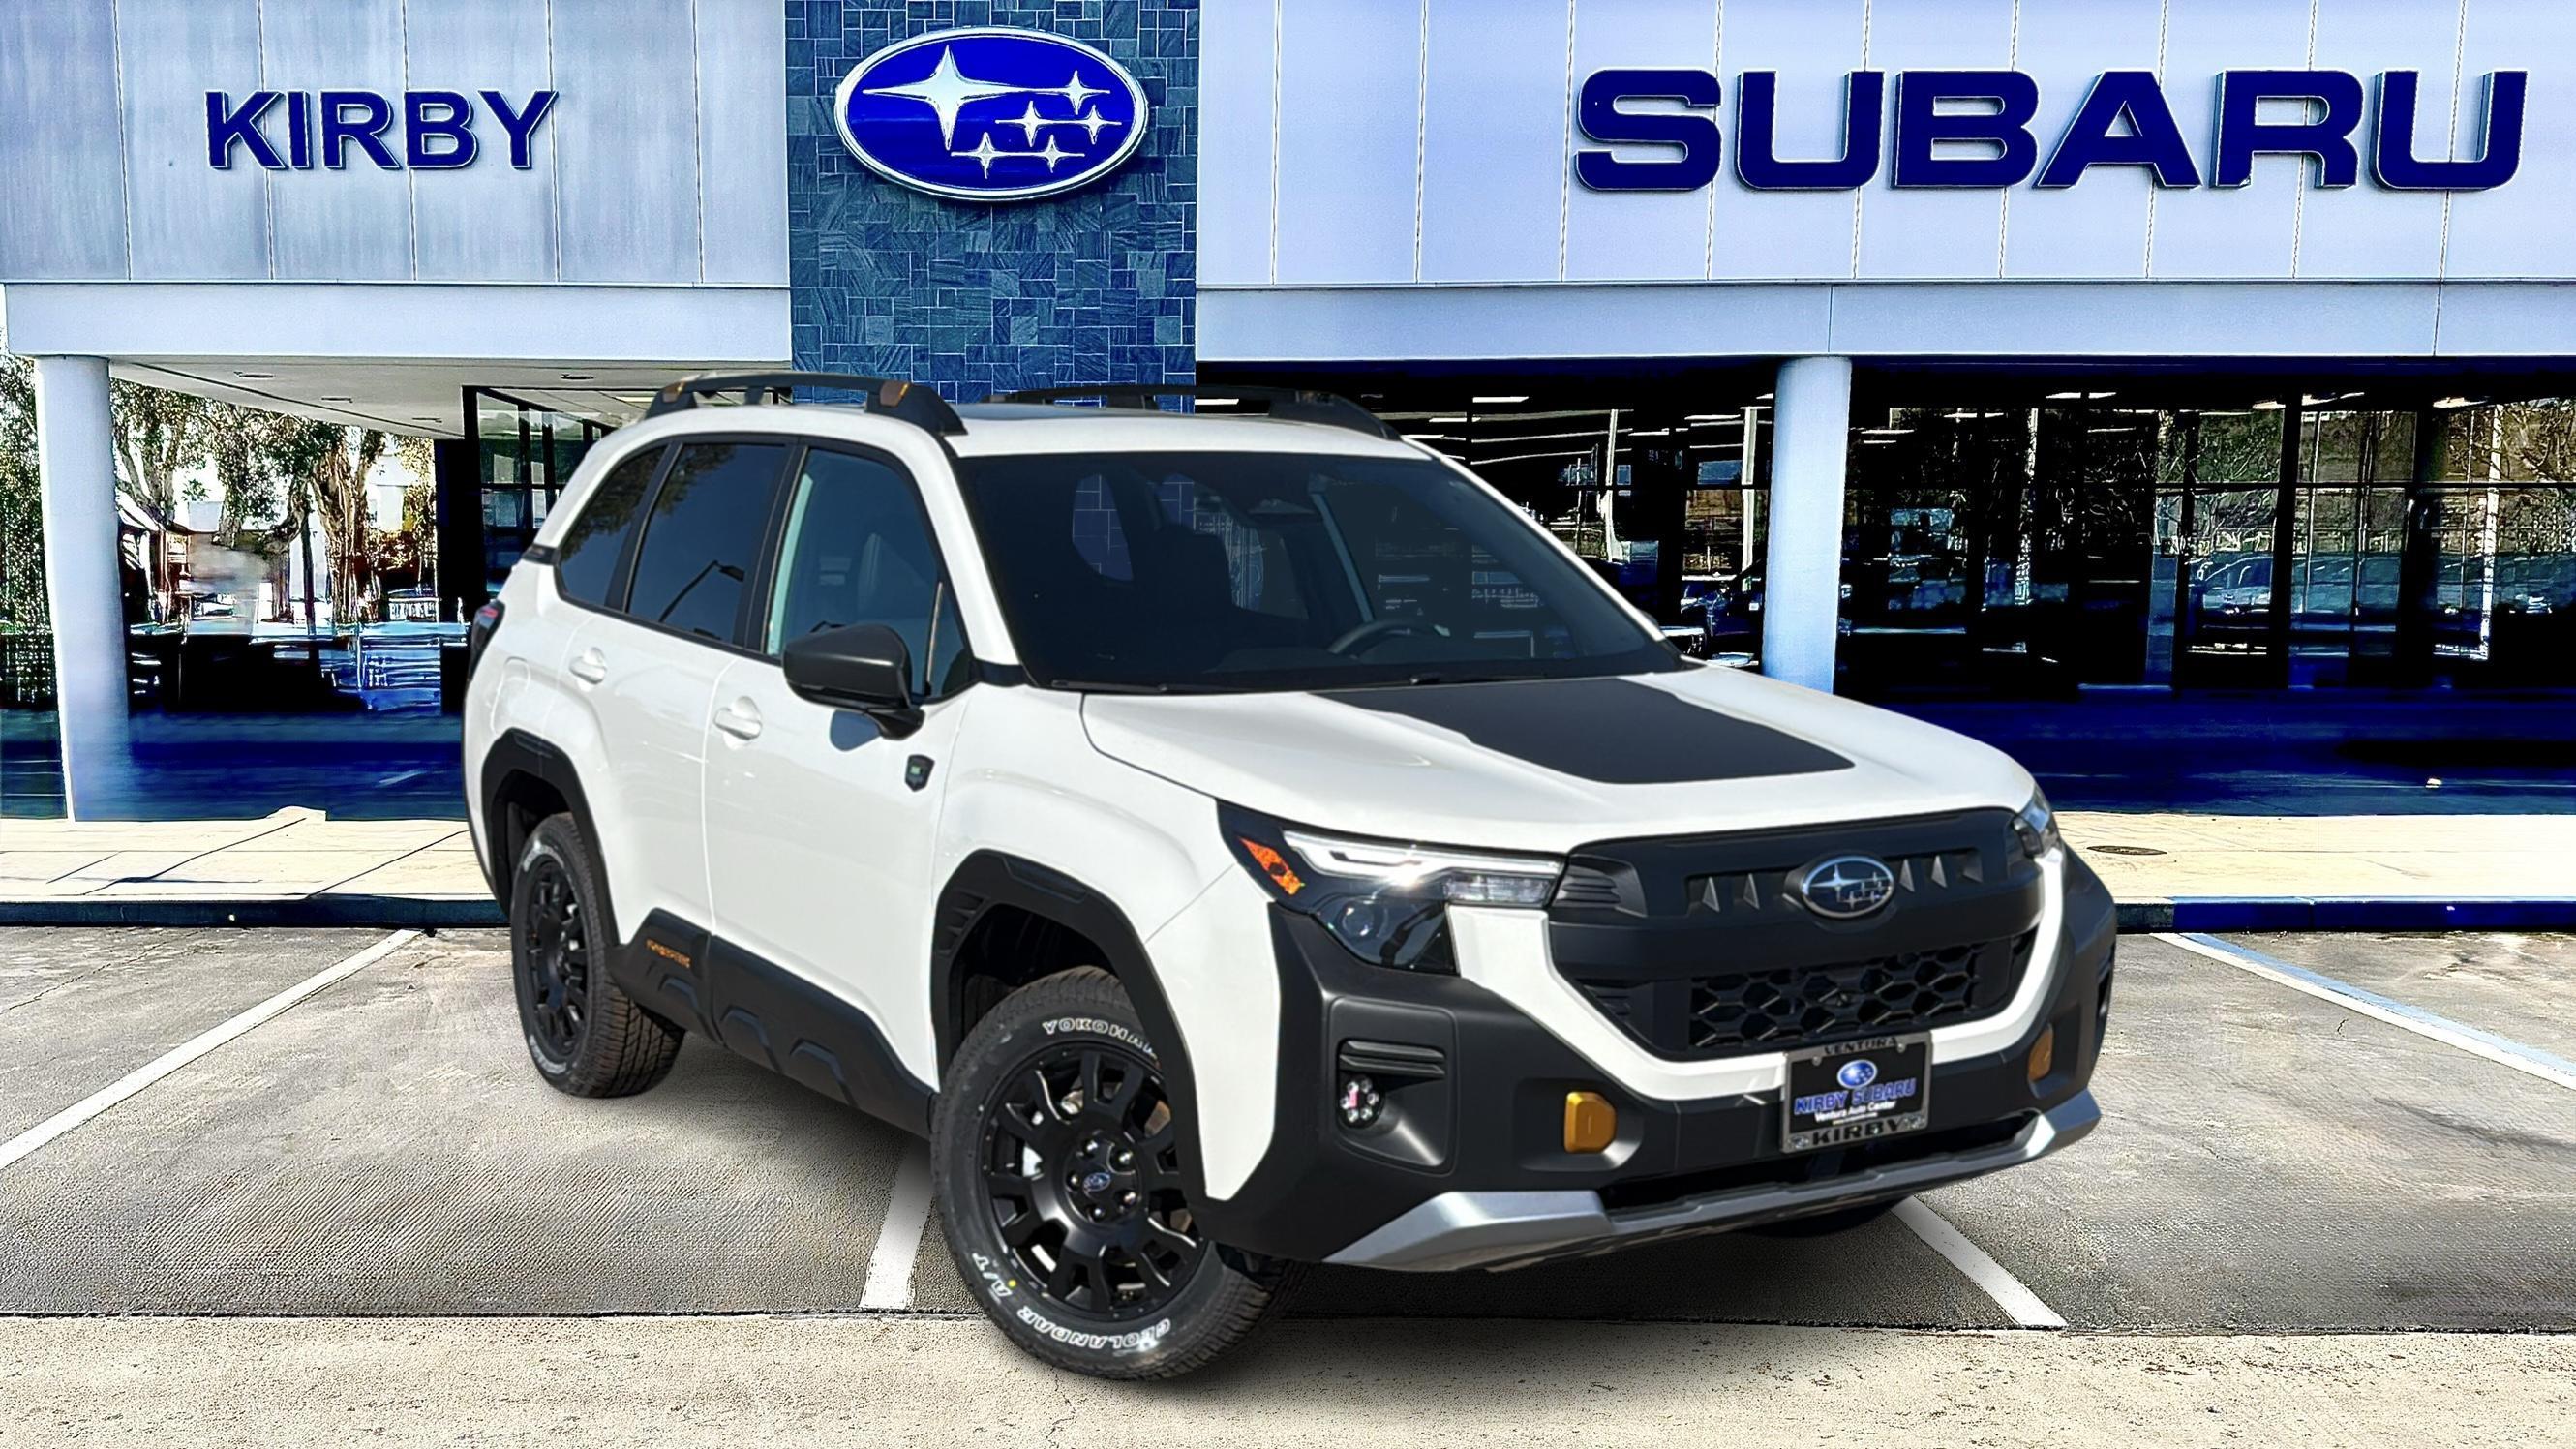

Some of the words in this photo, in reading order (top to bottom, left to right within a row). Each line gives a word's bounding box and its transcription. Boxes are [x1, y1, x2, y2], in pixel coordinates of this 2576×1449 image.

[204, 89, 559, 170] KIRBY
[1575, 68, 2529, 192] SUBARU
[1824, 1037, 1896, 1055] VENTURA
[1794, 1090, 1848, 1115] KIRBY
[1851, 1078, 1916, 1105] SUBARU
[1848, 1104, 1867, 1116] Auto
[1867, 1100, 1896, 1112] Center
[1812, 1118, 1903, 1145] KIRBY
[1016, 1305, 1171, 1350] GEOLANDAR
